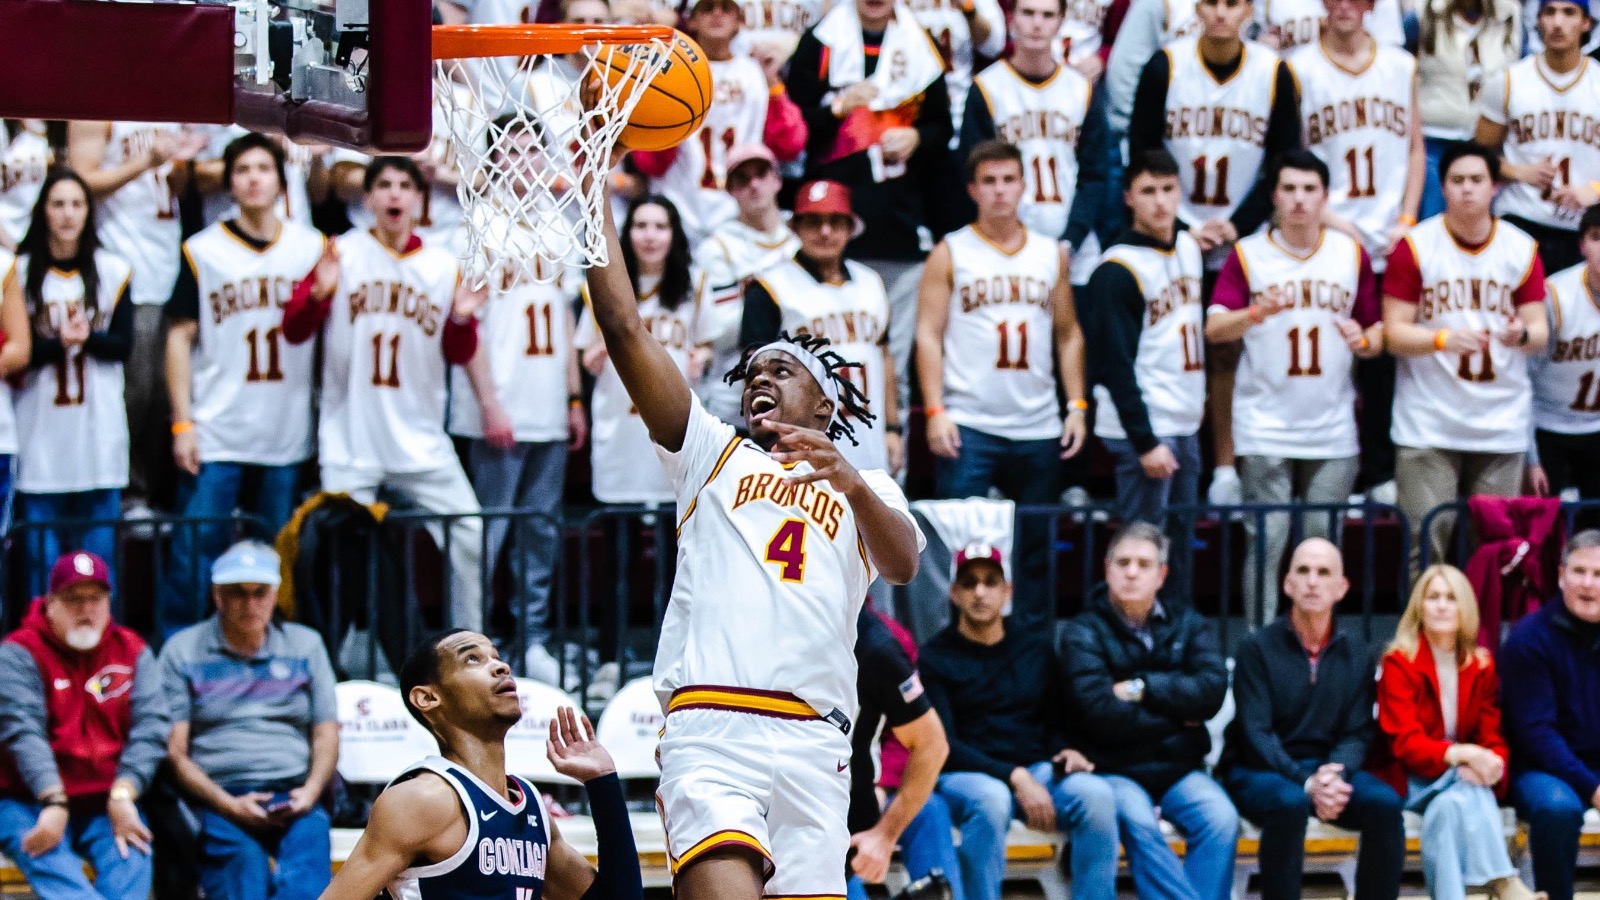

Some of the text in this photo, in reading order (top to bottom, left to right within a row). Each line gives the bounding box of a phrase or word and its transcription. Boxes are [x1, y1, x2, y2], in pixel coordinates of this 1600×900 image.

[1308, 97, 1406, 145] BRONCOS
[1031, 156, 1063, 203] 11
[1190, 154, 1230, 206] 11
[1344, 146, 1377, 198] 11
[210, 277, 290, 325] BRONC
[1420, 279, 1512, 320] BRONCO
[246, 328, 284, 382] 11
[526, 302, 554, 356] 11
[996, 322, 1029, 370] 11
[1287, 325, 1321, 377] 11
[372, 333, 401, 387] 11
[732, 473, 844, 541] BRONCOS
[763, 516, 808, 584] 4
